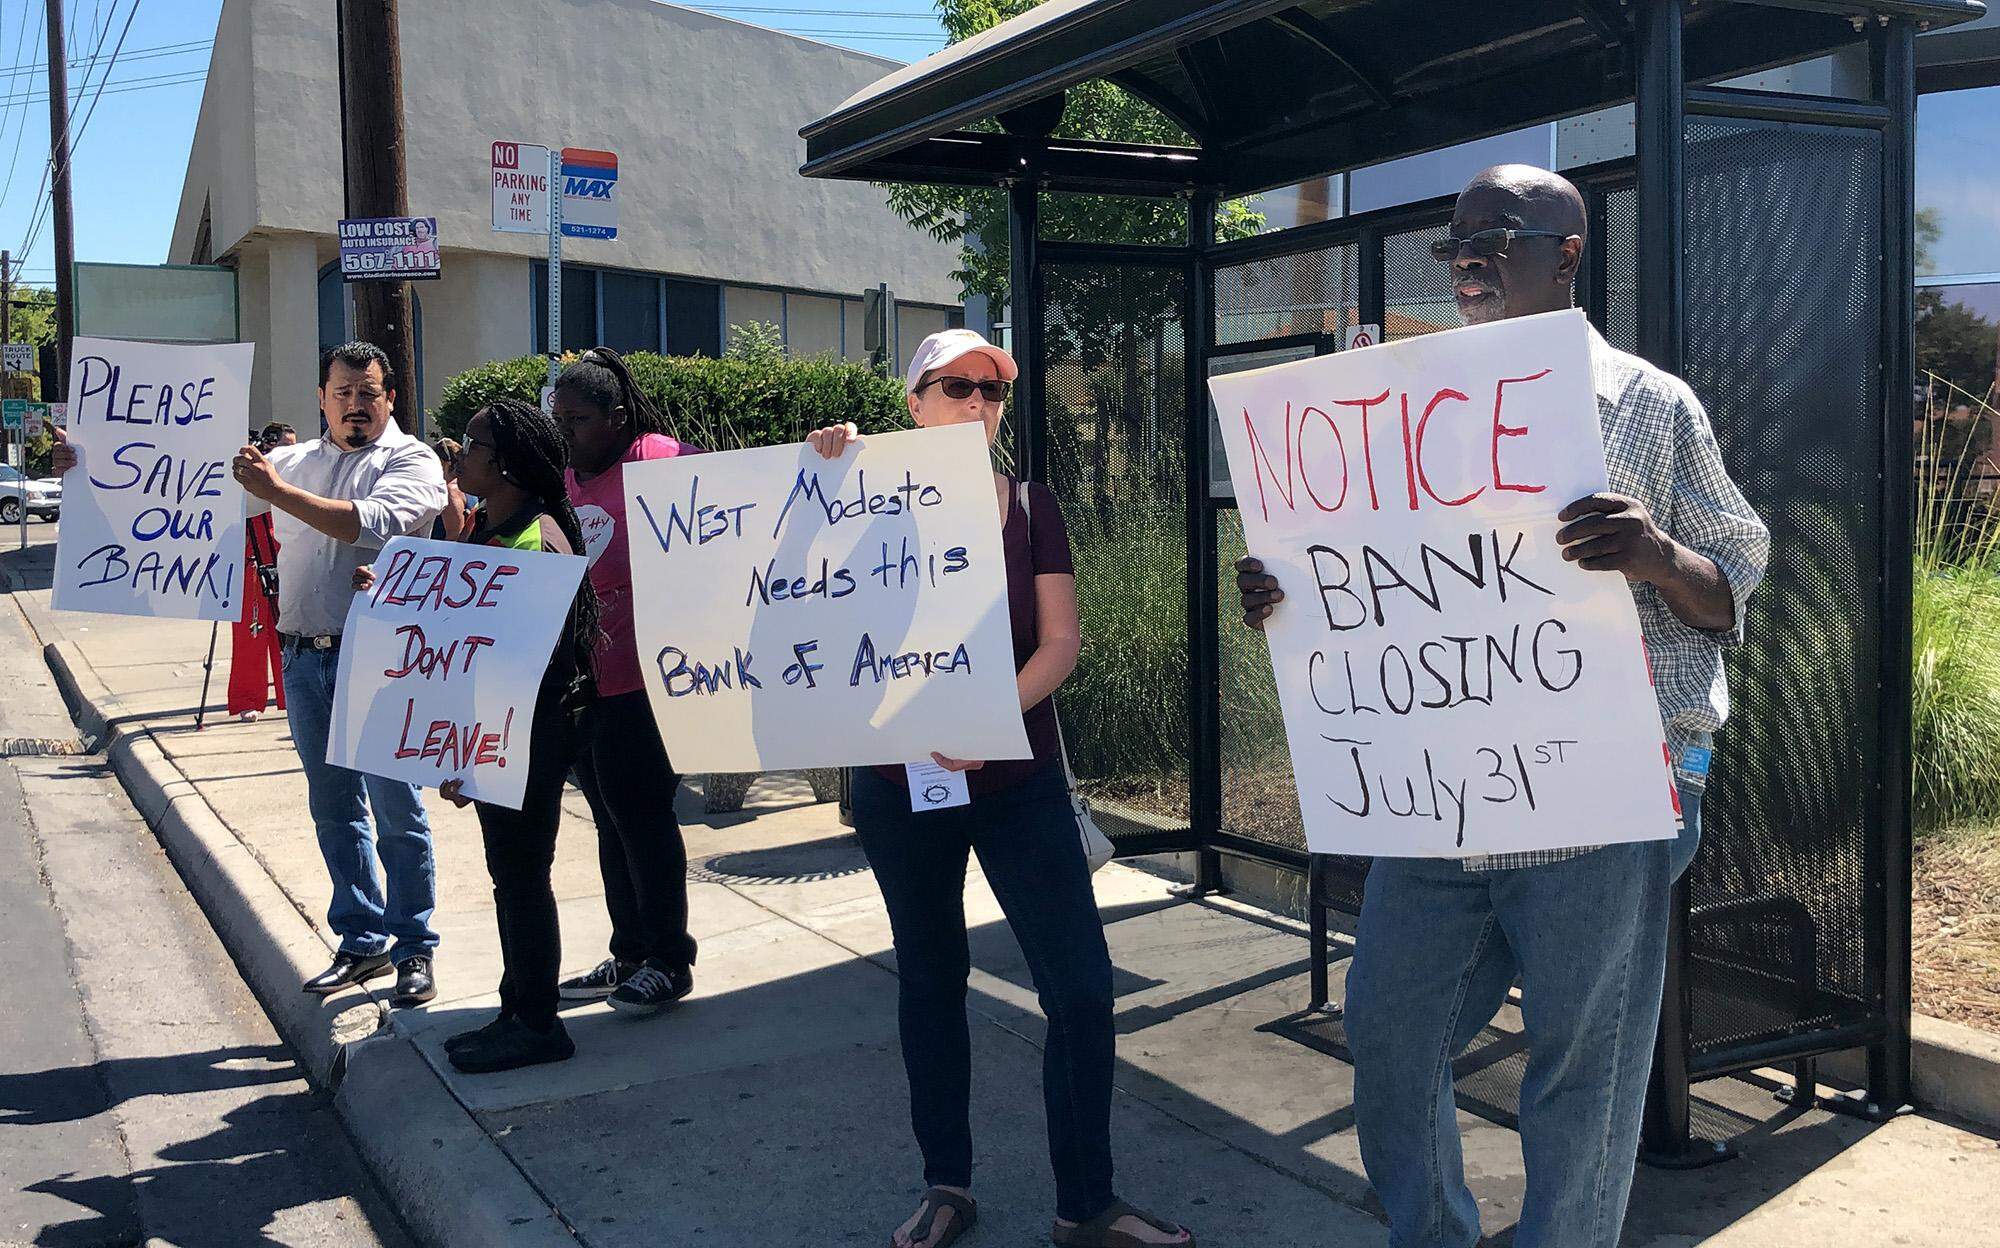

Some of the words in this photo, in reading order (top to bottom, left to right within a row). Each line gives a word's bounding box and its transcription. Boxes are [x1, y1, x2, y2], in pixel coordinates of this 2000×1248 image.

[495, 146, 515, 166] NO
[495, 172, 547, 192] PARKING
[510, 208, 532, 221] TIME
[511, 193, 531, 206] ANY
[564, 178, 615, 198] MAX
[341, 223, 371, 238] LOW
[374, 222, 411, 236] COST
[342, 239, 365, 248] AUTO
[367, 237, 416, 247] INSURANCE
[345, 252, 435, 270] 567-1111
[571, 226, 606, 235] 521-1274
[78, 356, 215, 425] PLEASE
[89, 441, 225, 505] SAVE
[1242, 368, 1553, 523] NOTICE
[132, 507, 214, 541] OUR
[636, 474, 757, 553] WEST
[773, 467, 942, 540] Modesto
[78, 543, 234, 609] BANK!
[370, 549, 520, 611] PLEASE
[746, 557, 856, 607] Needs
[871, 536, 970, 589] this
[1307, 529, 1557, 633] BANK
[656, 645, 764, 698] BANK
[849, 632, 971, 688] AMERICA
[1308, 618, 1583, 716] CLOSING
[395, 698, 514, 772] LEAVE!
[1319, 732, 1466, 848] July
